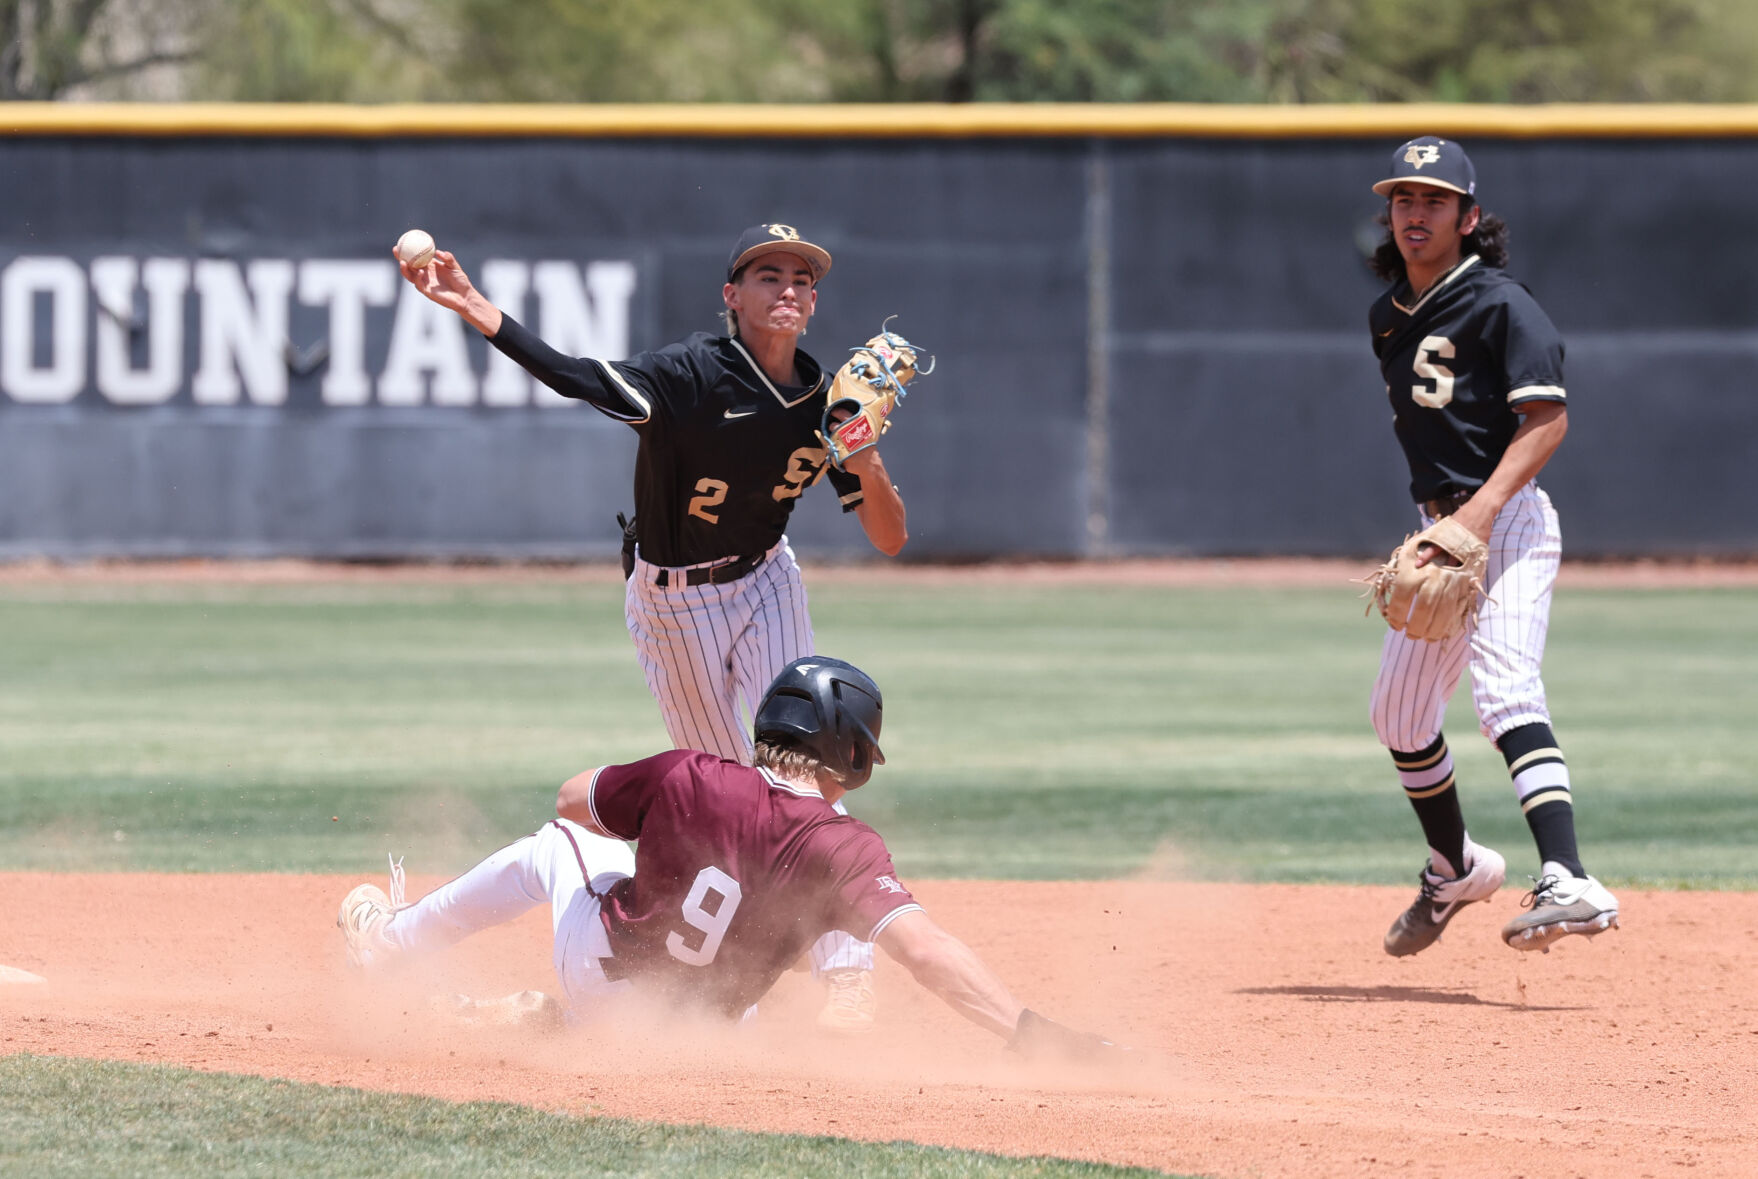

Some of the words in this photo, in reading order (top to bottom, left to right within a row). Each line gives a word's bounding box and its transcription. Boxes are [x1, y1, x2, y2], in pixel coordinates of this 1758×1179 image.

[1412, 335, 1456, 409] S
[688, 477, 729, 525] 2
[772, 447, 829, 503] S
[666, 865, 742, 967] 9
